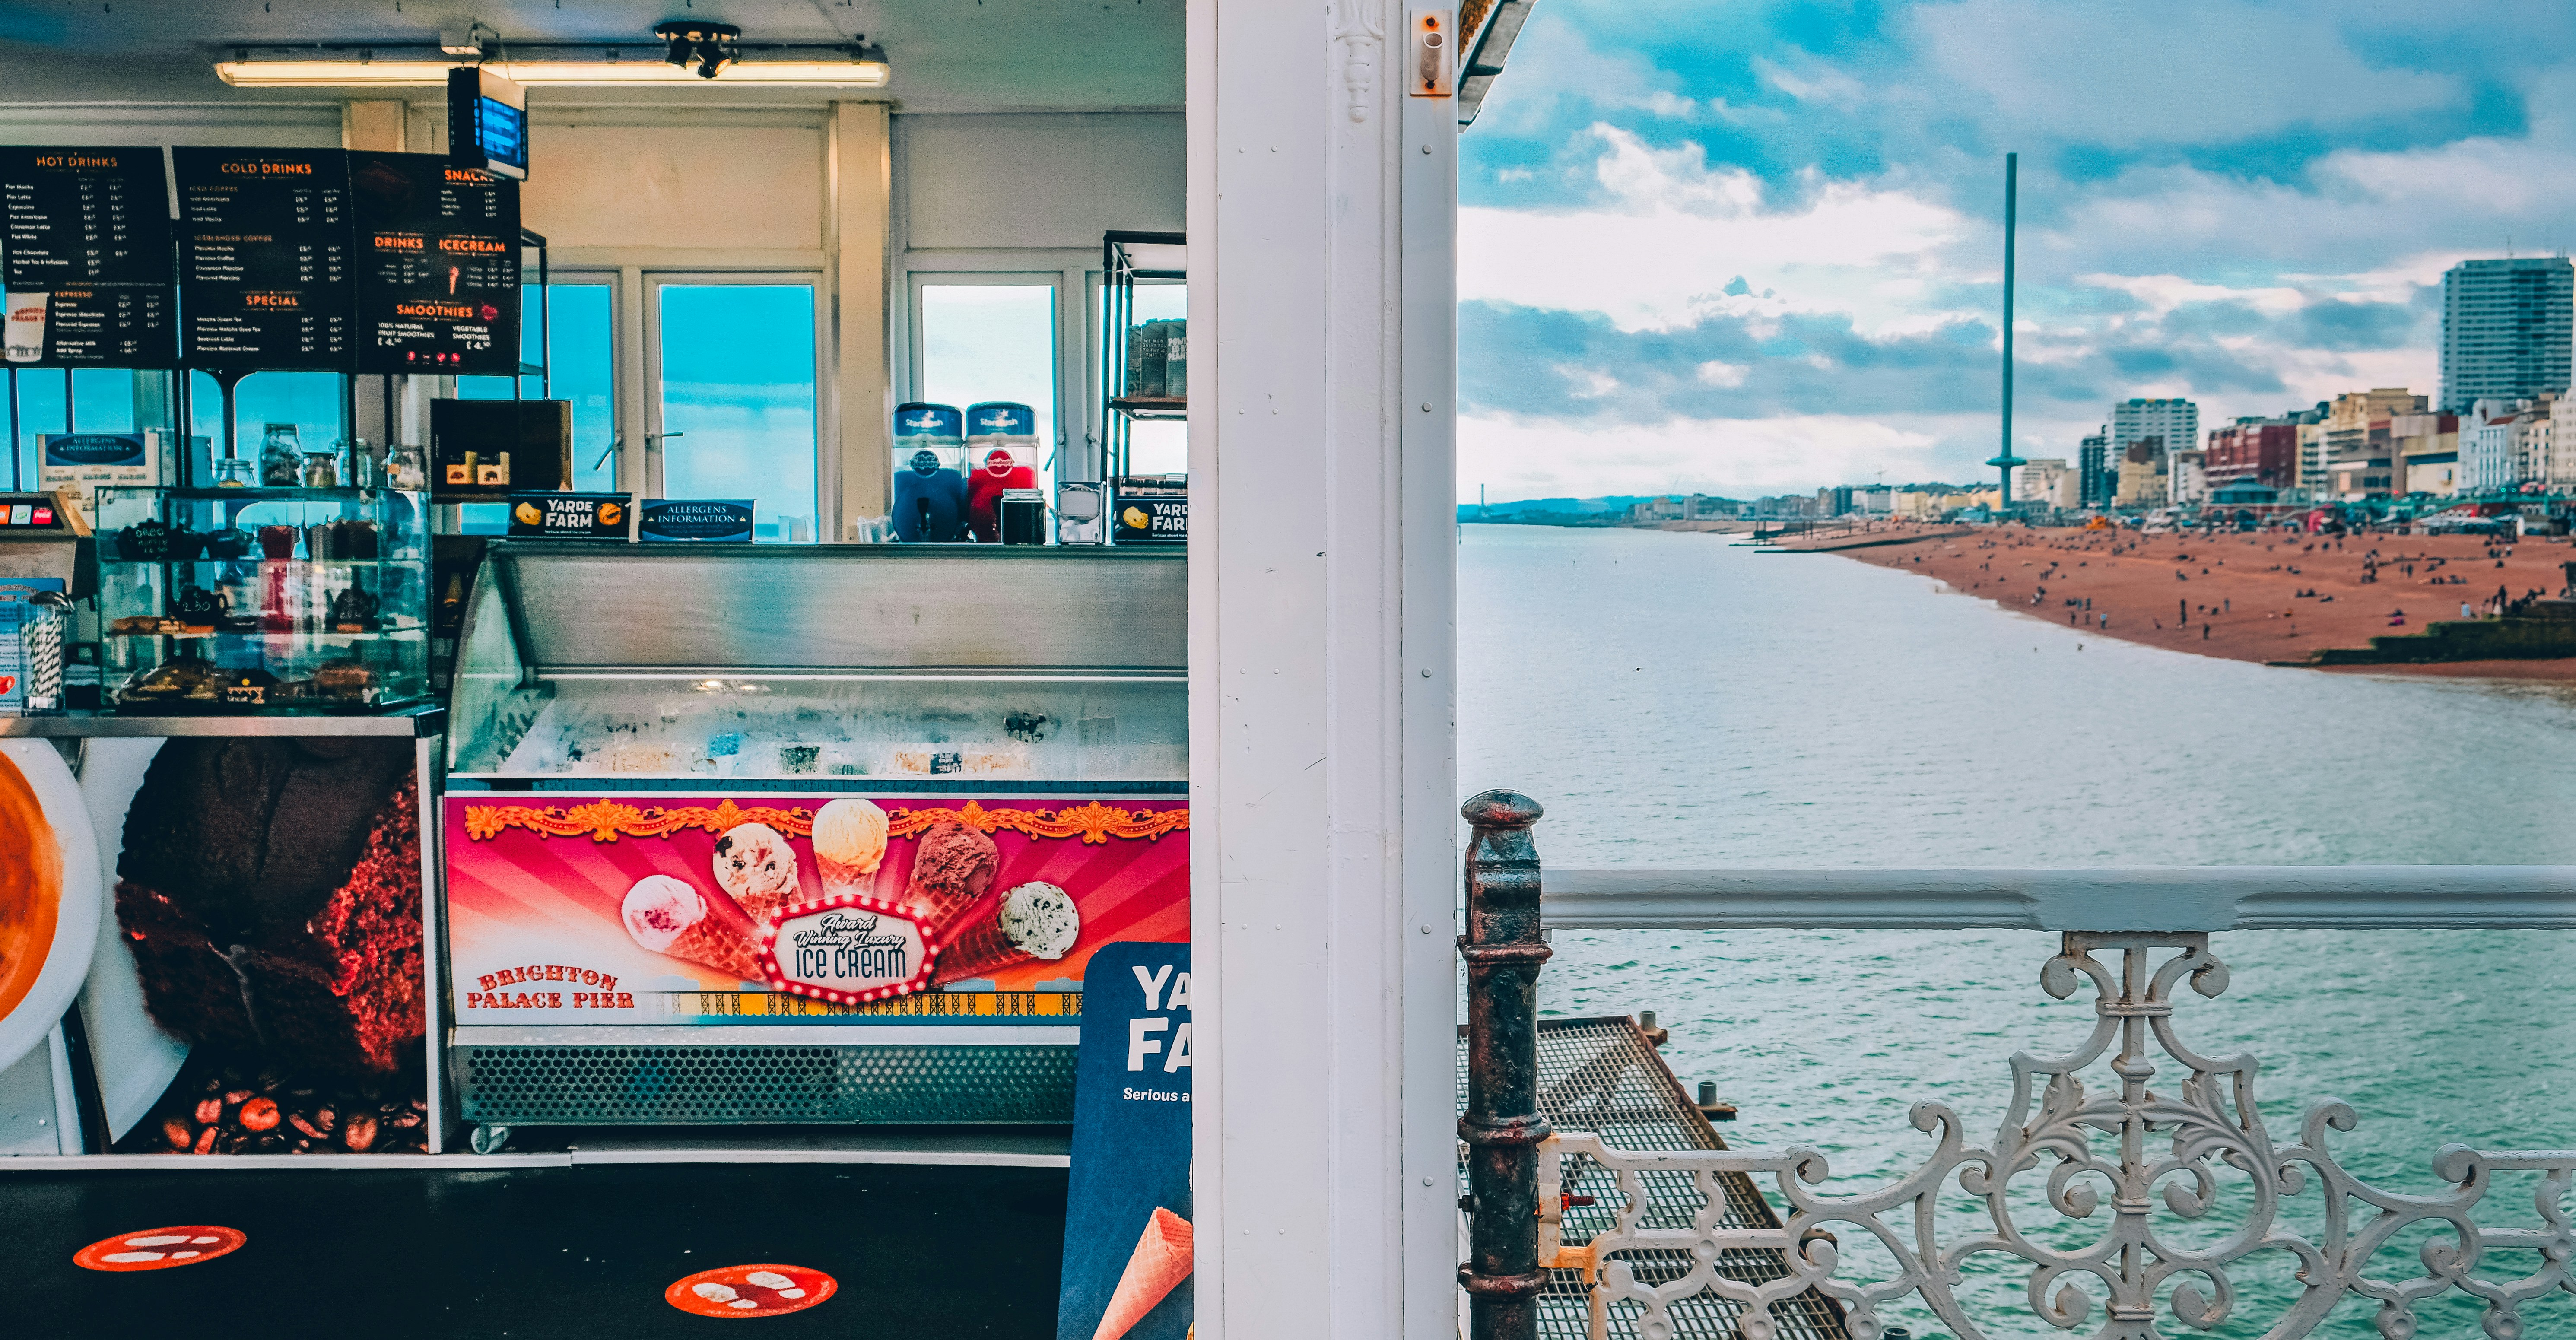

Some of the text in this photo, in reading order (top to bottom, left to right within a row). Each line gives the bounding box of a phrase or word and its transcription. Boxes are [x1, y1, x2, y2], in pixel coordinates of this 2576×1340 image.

[37, 157, 117, 167] HOT DRINKS
[221, 163, 312, 174] COLD DRINKS
[445, 169, 494, 182] SNAC
[375, 236, 423, 248] DRINKS
[439, 239, 506, 252] ICECREAM
[246, 295, 298, 306] SPECIAL
[396, 304, 473, 318] SMOOTHIES
[395, 323, 424, 331] NATURAL
[397, 330, 435, 339] SMOOTHIES
[546, 499, 593, 513] YARDE
[667, 505, 726, 514] ALLERGENS
[545, 512, 593, 528] FARM
[658, 514, 735, 523] INFORMATION
[1152, 516, 1187, 531] FAR
[821, 914, 877, 935] Award
[794, 930, 906, 950] Winning Luxury
[796, 949, 906, 978] ICE CREAM
[477, 965, 618, 992] BRIGHTON
[467, 992, 635, 1009] PALACE PIER
[1123, 1087, 1178, 1102] Serious
